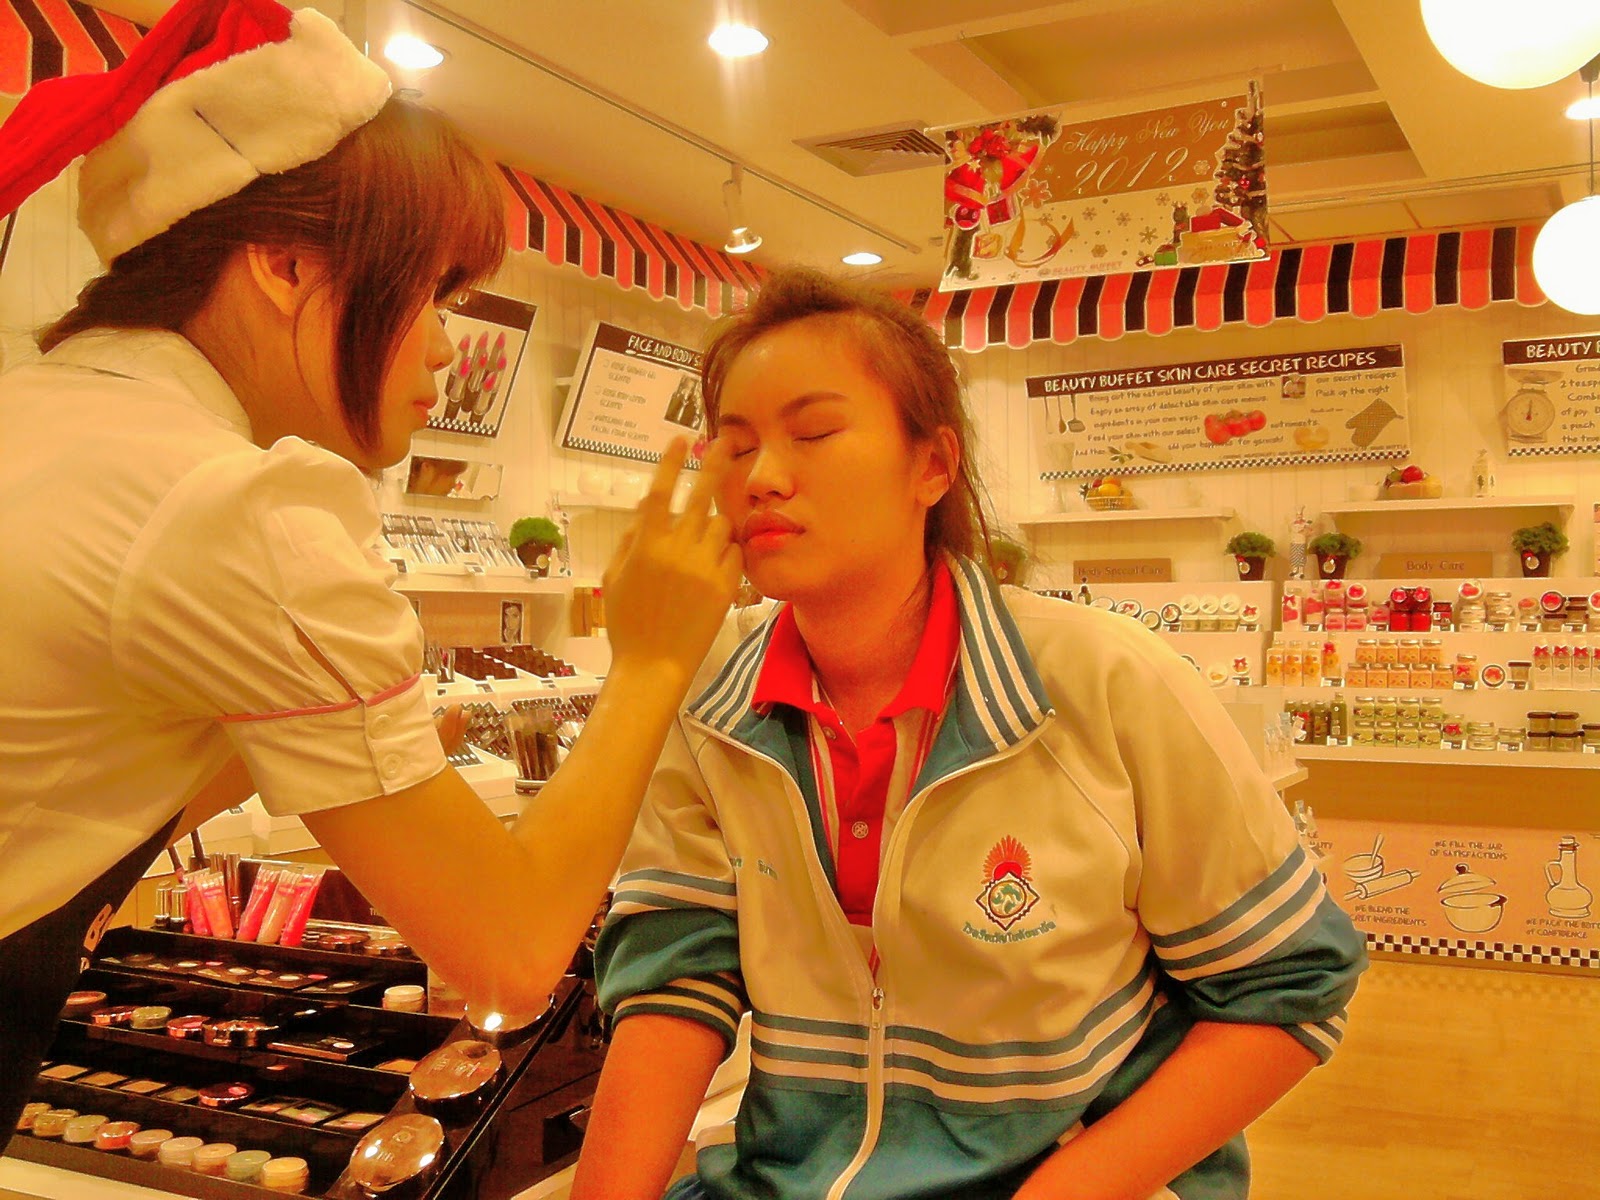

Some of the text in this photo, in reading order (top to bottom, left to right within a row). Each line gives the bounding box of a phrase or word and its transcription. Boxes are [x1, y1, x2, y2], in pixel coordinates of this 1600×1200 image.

[1062, 128, 1129, 156] Happy
[1135, 115, 1181, 143] New
[1066, 146, 1189, 195] 2012
[628, 335, 653, 352] FACE
[653, 343, 672, 358] AND
[672, 348, 694, 364] BODY
[1526, 341, 1593, 358] BEAUTY
[1045, 351, 1377, 393] BEAUTY BUFFET SKIN CARE SECRET RECIPES
[1174, 386, 1201, 395] beauty
[1561, 407, 1572, 415] of
[1406, 560, 1433, 574] Body
[1468, 841, 1484, 849] THE
[1394, 907, 1410, 915] THE
